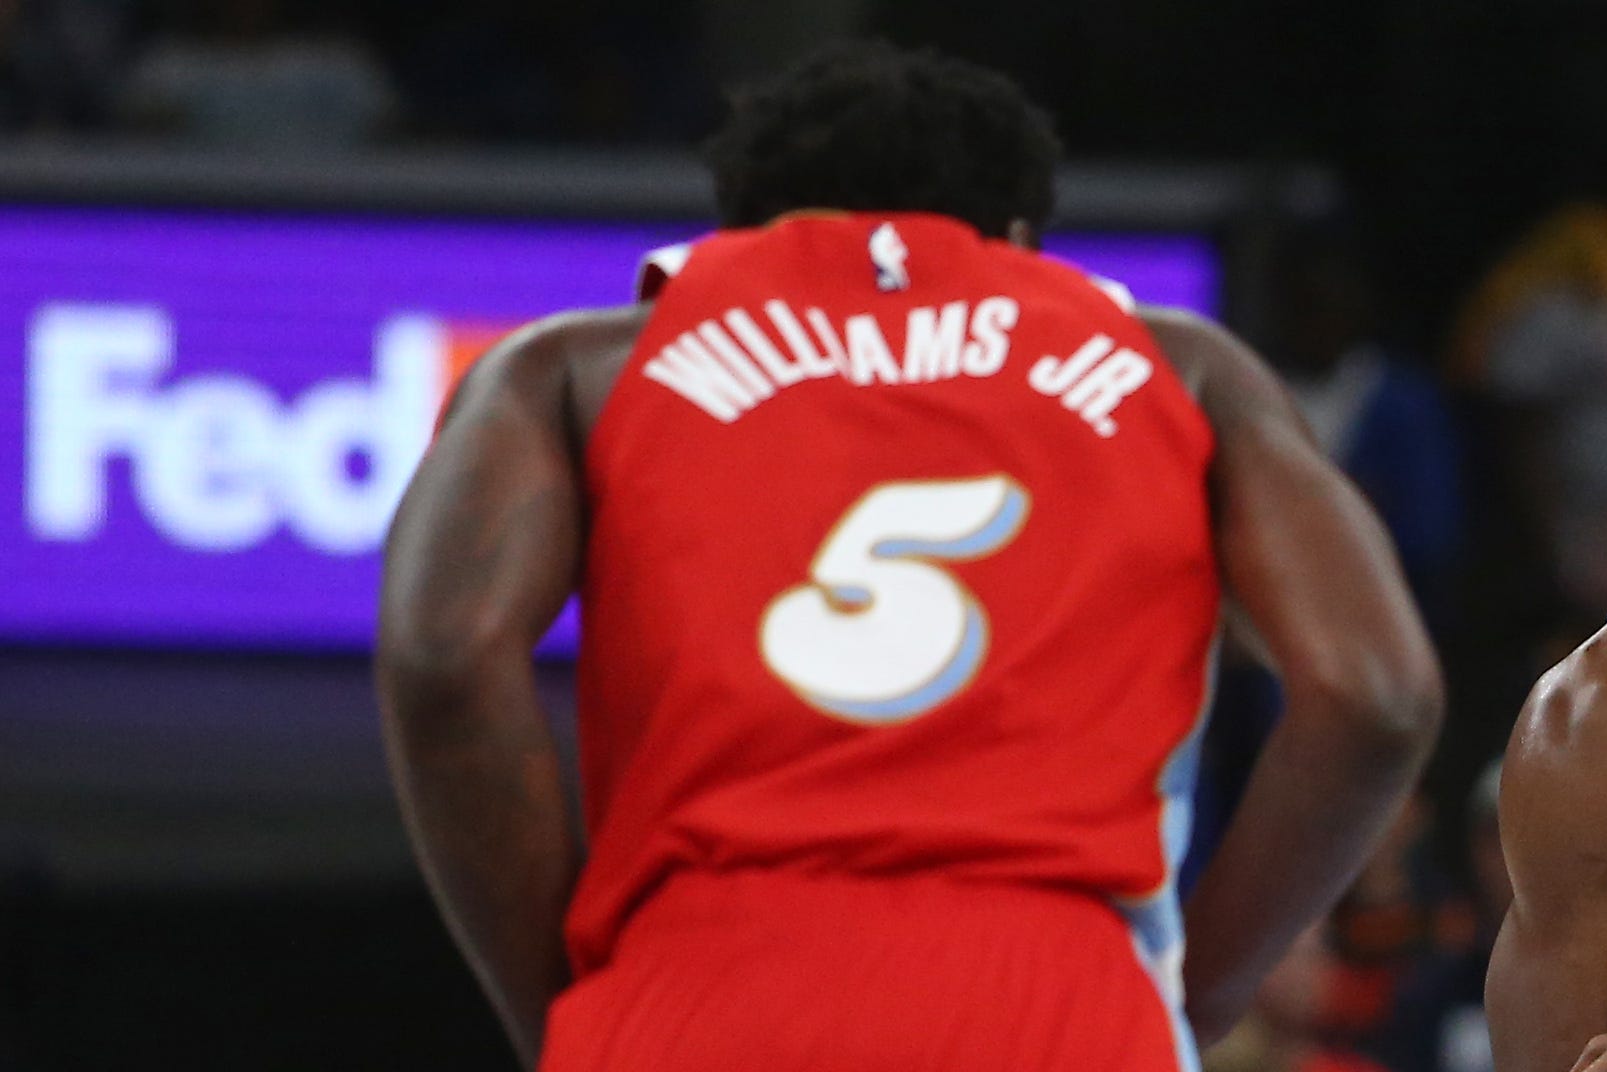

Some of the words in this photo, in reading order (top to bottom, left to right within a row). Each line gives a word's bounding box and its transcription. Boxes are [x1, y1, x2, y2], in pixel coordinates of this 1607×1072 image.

[27, 305, 525, 554] Fed
[643, 296, 1018, 423] WILLIAMS
[1028, 333, 1153, 438] JR.
[760, 470, 1032, 726] 5
